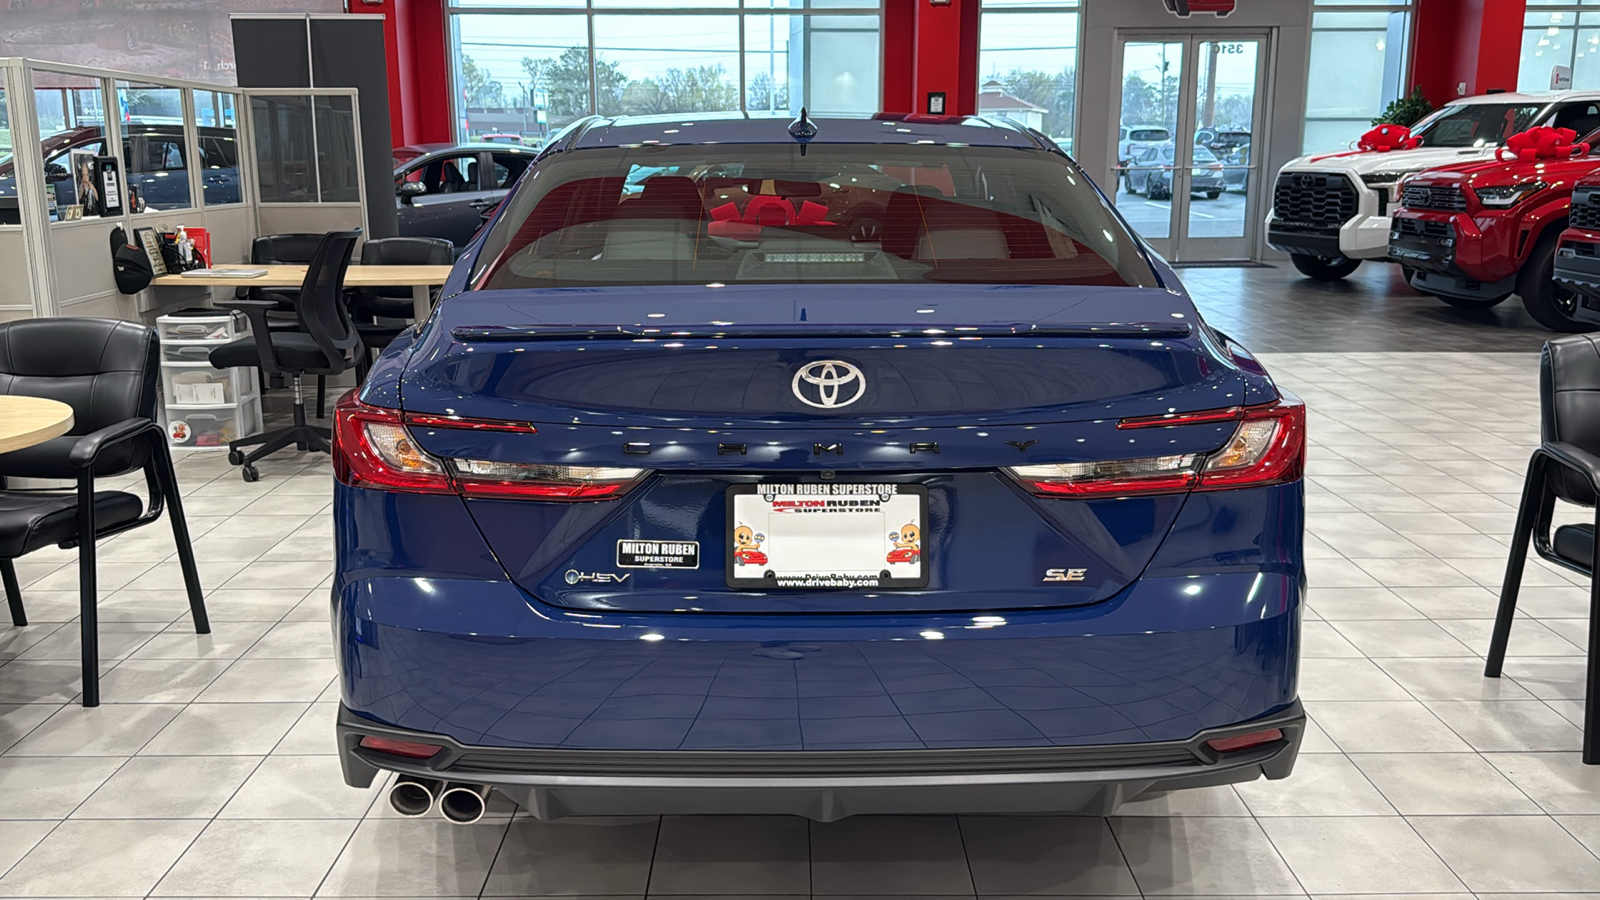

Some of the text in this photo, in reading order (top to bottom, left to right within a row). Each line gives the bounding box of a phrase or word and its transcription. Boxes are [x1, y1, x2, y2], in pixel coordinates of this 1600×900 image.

[622, 441, 1039, 455] CAMRY
[757, 484, 898, 495] MILTON RUBEN SUPERSTORE
[622, 542, 695, 556] MILTON RUBEN
[634, 555, 684, 563] SUPERSTORE
[1042, 568, 1088, 582] SE
[777, 579, 879, 588] www.drivebaby.com
